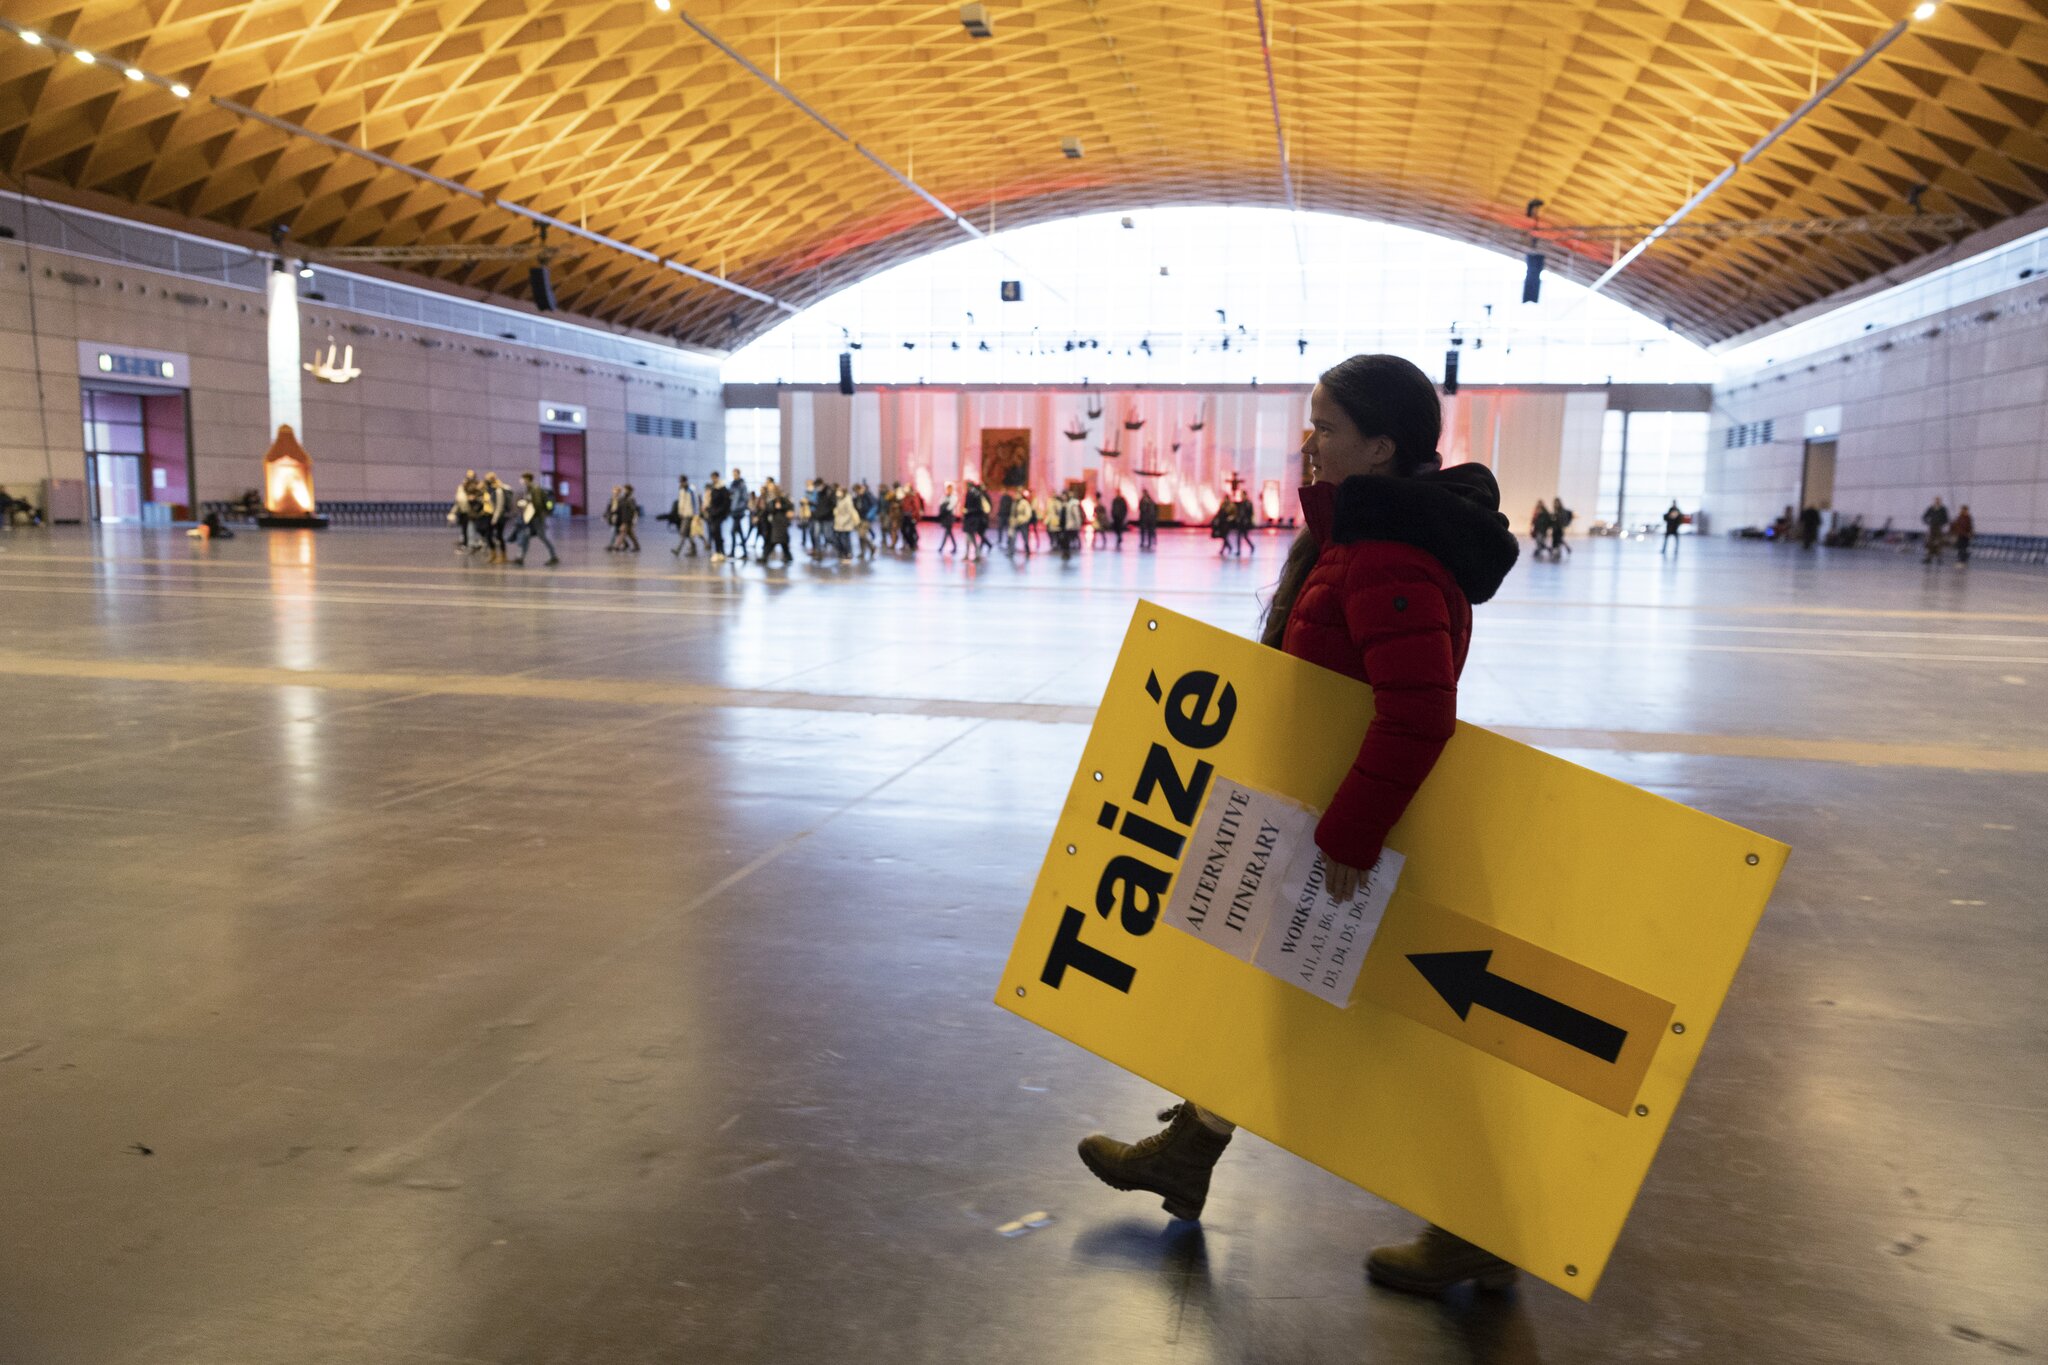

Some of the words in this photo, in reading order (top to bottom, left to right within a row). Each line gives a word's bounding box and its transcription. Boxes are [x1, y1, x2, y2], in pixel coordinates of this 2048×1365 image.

[1040, 668, 1237, 994] Taizé
[1186, 790, 1250, 931] ALTERNATIVE
[1225, 818, 1280, 933] ITINERARY
[1349, 900, 1368, 921] D6,
[1319, 912, 1337, 931] B6,
[1340, 923, 1359, 943] D5,
[1311, 934, 1328, 954] A3,
[1331, 946, 1350, 966] D4,
[1322, 969, 1342, 989] D3,
